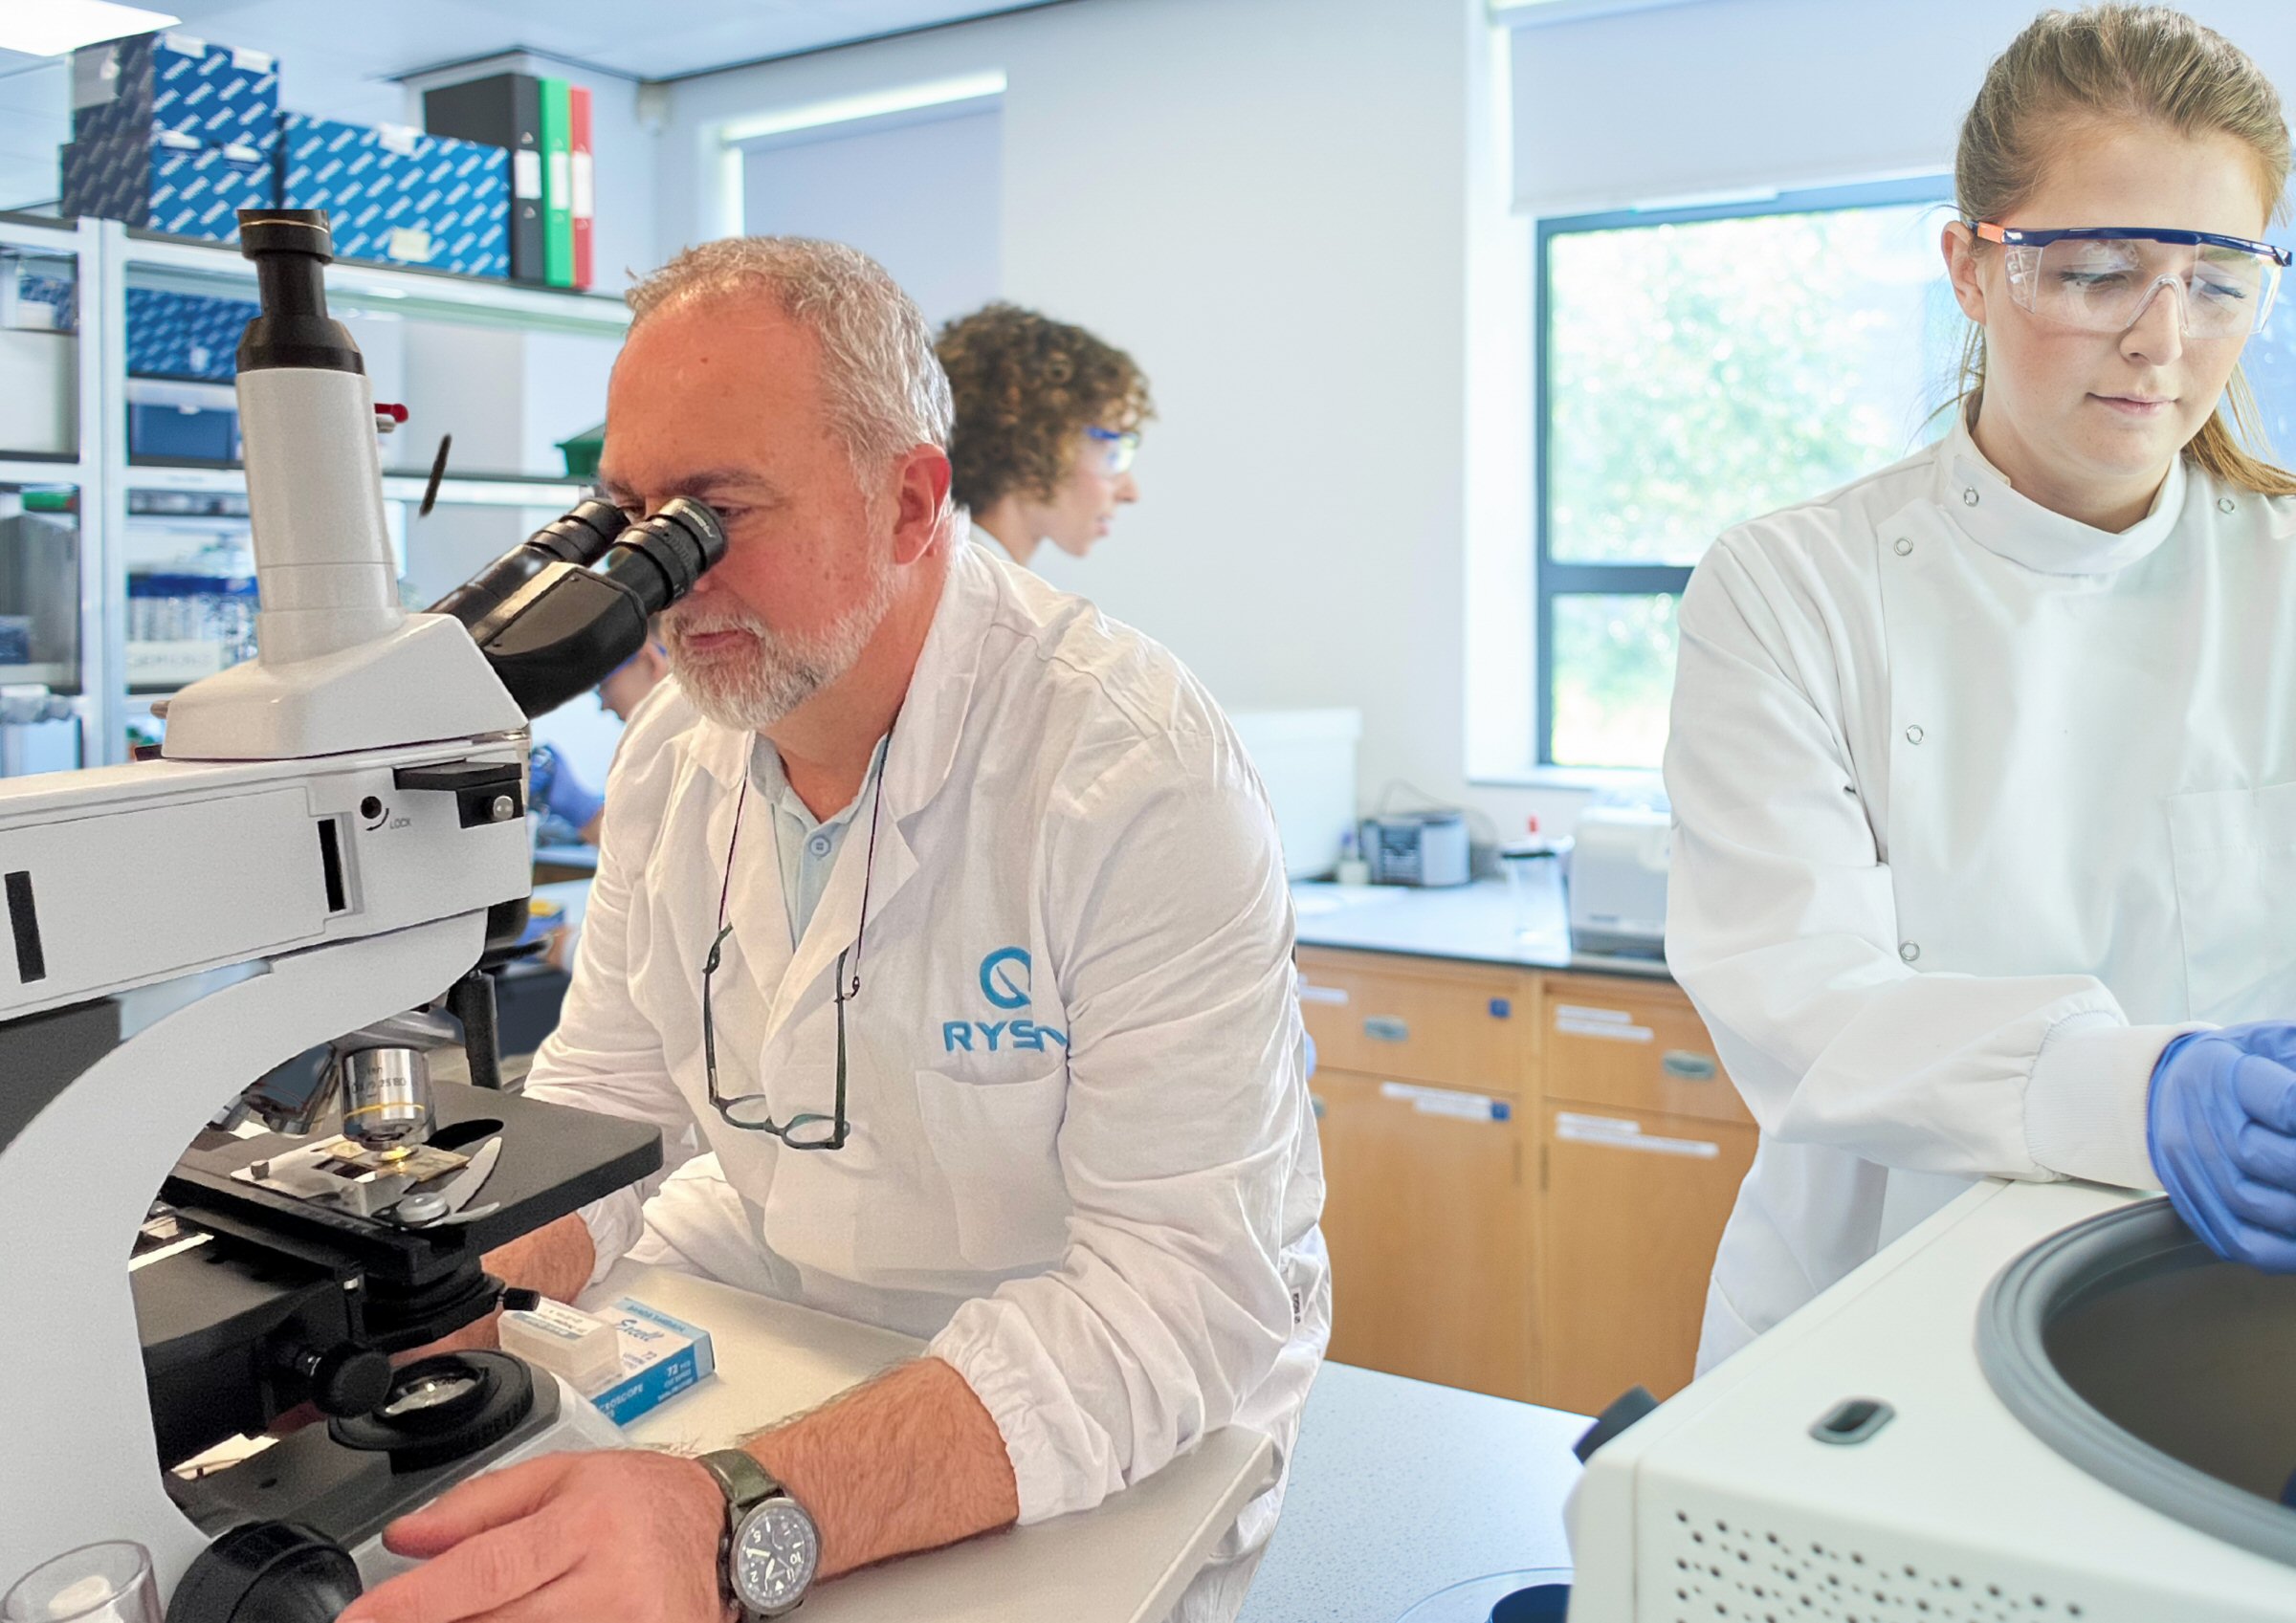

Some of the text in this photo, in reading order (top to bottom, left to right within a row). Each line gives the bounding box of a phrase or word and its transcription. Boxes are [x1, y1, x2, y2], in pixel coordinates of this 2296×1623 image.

[753, 1530, 762, 1544] 5
[789, 1551, 802, 1565] 10
[749, 1570, 759, 1584] 2
